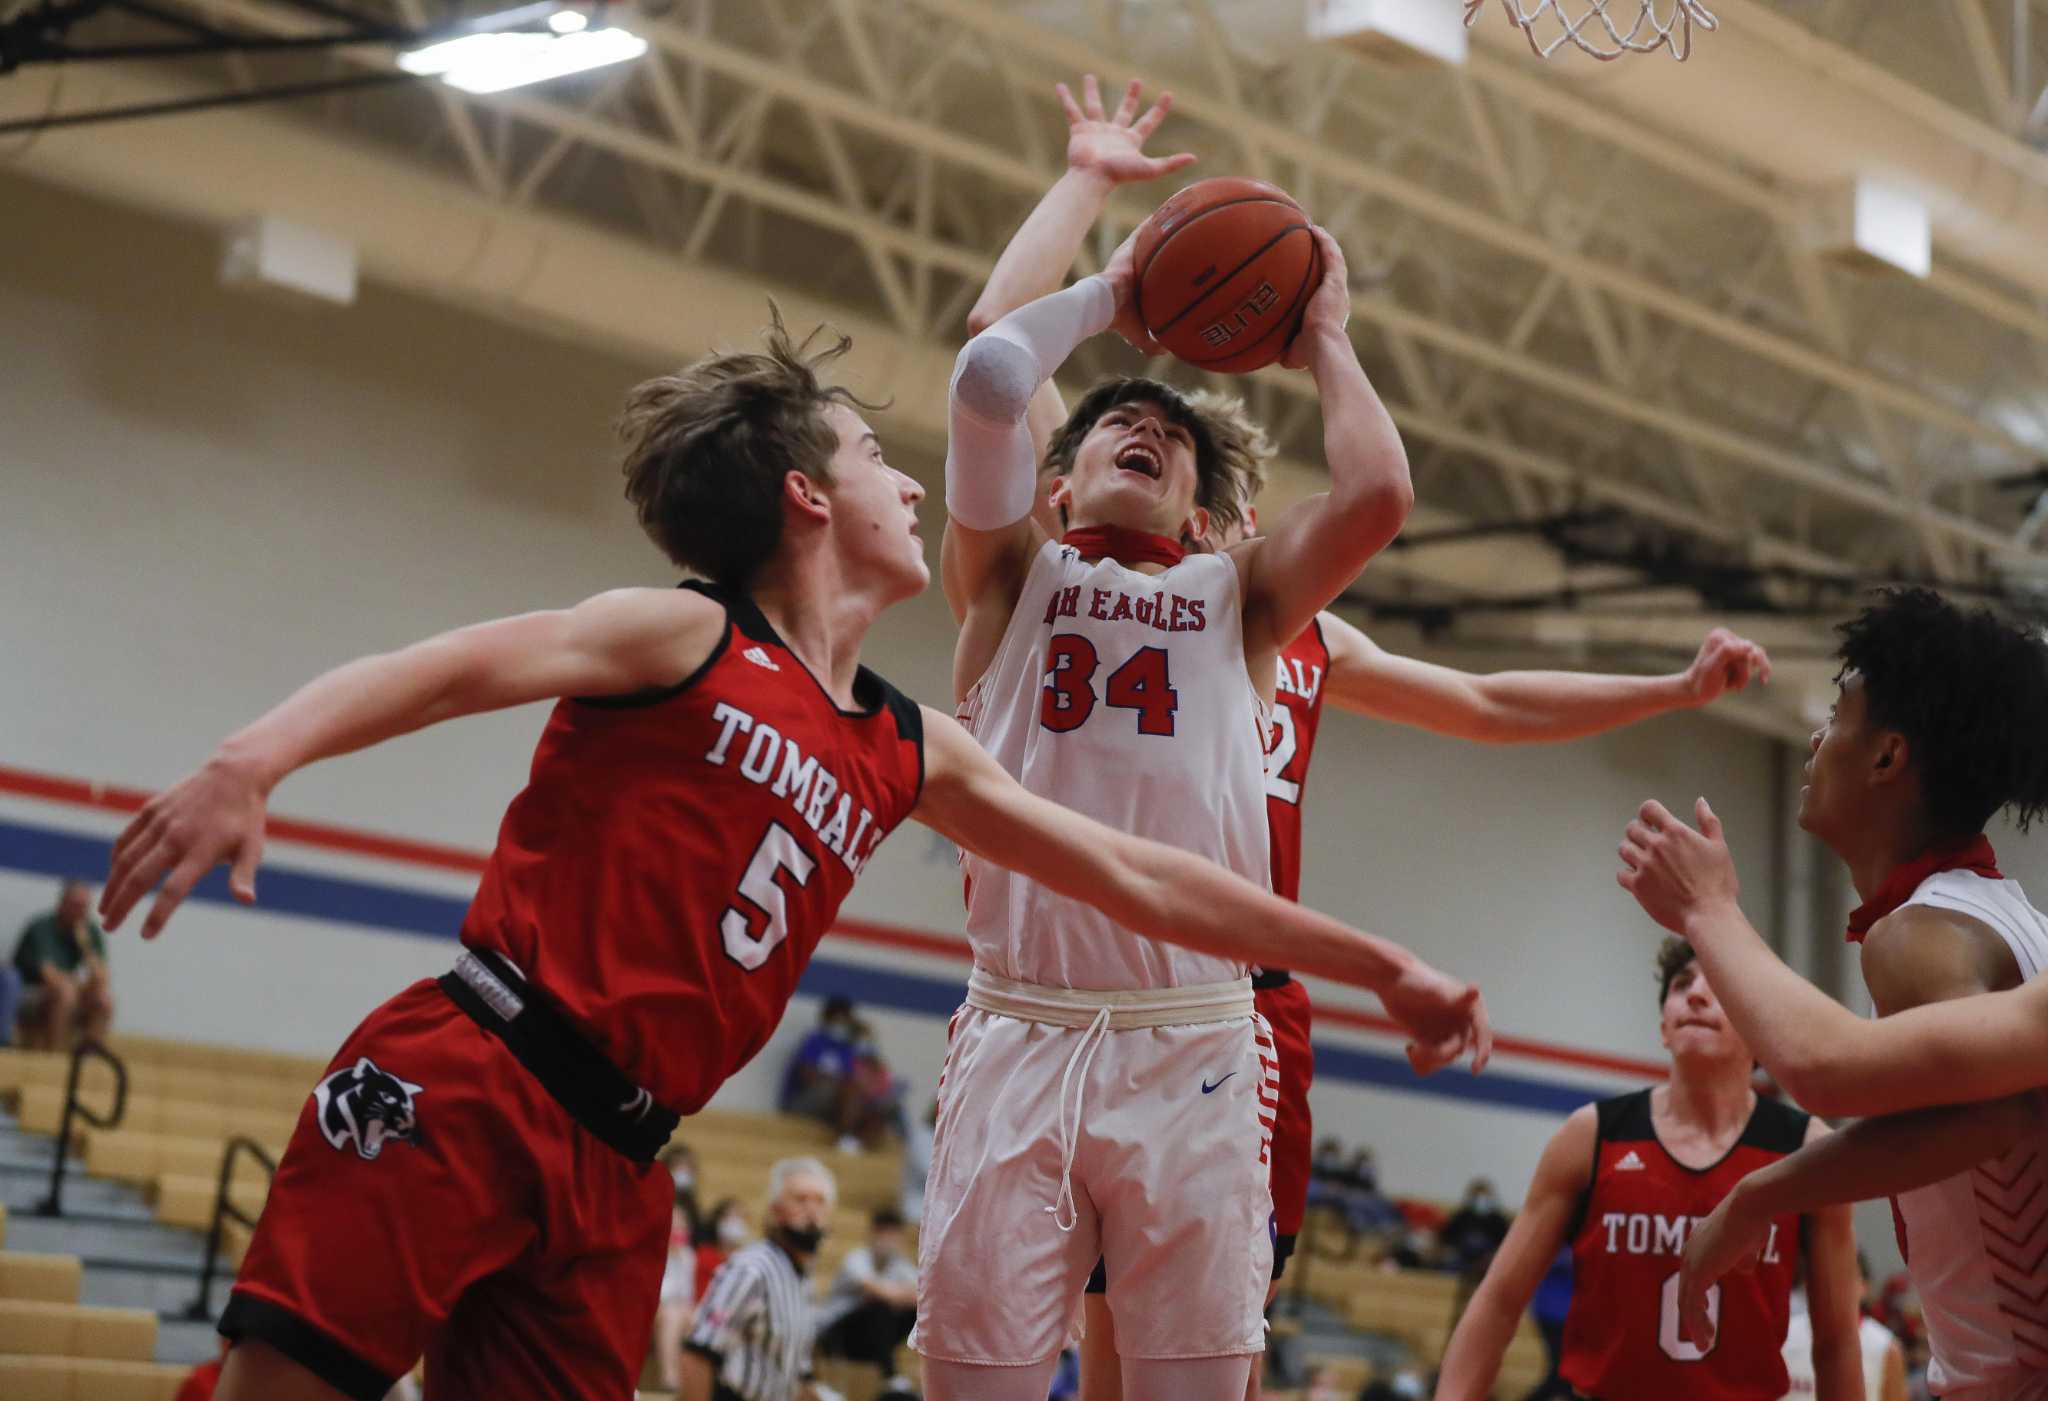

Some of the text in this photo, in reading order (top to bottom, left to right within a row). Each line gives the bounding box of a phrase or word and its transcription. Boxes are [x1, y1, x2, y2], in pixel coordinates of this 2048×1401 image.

[1200, 281, 1280, 347] ELITE
[1088, 587, 1207, 632] EAGLES
[1040, 633, 1178, 737] 34
[1264, 701, 1300, 805] 2
[717, 816, 818, 972] 5
[1603, 1213, 1780, 1264] TOML
